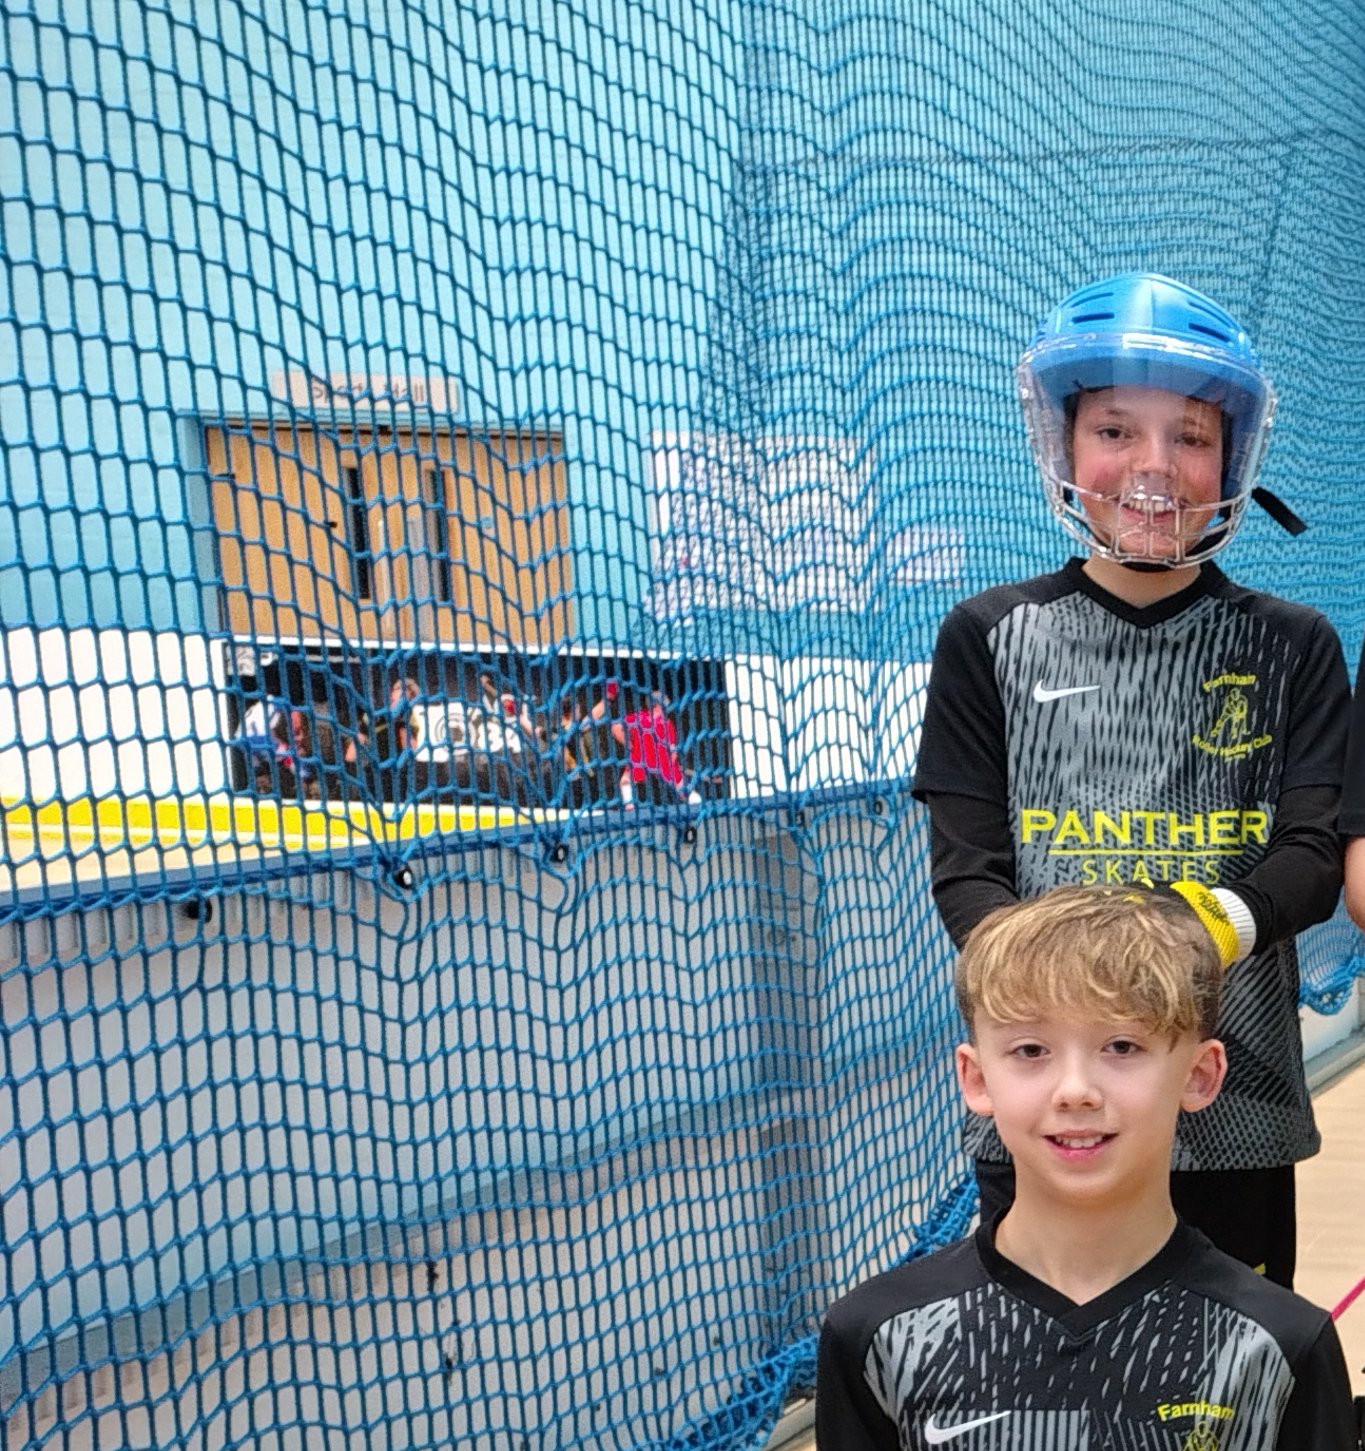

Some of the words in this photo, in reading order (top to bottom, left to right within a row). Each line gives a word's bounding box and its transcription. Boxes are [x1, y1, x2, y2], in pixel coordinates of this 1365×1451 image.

[1020, 808, 1268, 845] PANTHER
[1082, 858, 1221, 886] SKATES
[1157, 1400, 1236, 1421] Farnham
